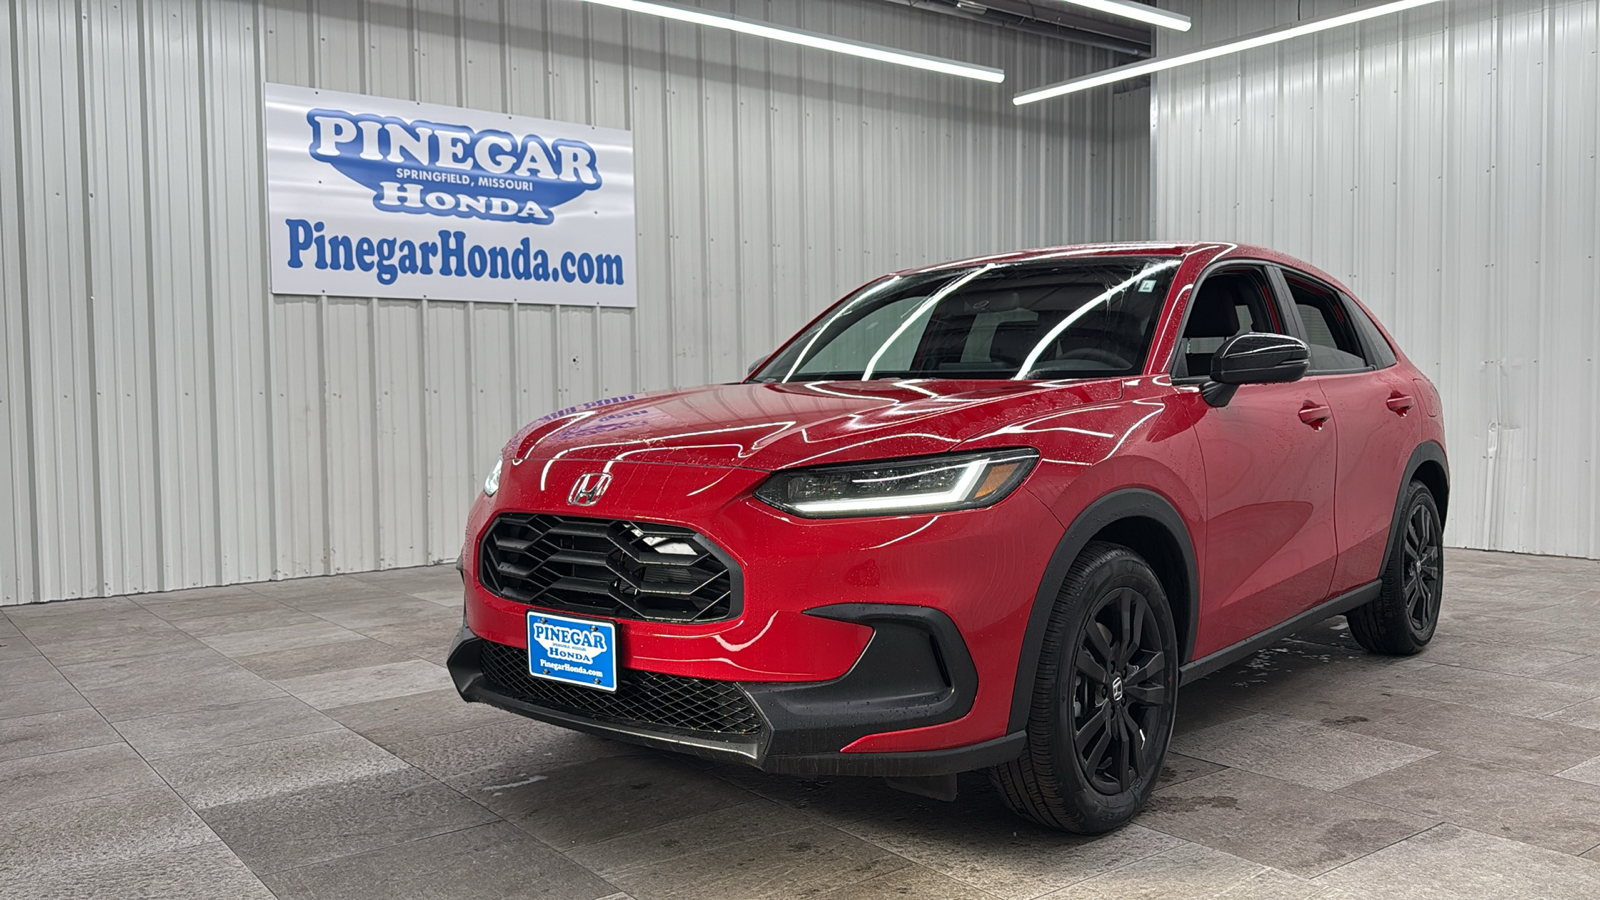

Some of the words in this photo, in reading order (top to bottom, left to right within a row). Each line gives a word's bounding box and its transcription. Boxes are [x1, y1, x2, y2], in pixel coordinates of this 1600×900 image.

[314, 116, 597, 184] PINEGAR
[396, 168, 475, 187] SPRINGFIELD,
[478, 176, 533, 192] MISSOURI
[380, 182, 548, 219] HONDA
[285, 219, 624, 285] PinegarHonda.com
[536, 625, 604, 649] PINEGAR
[549, 647, 591, 662] HONDA
[540, 659, 603, 677] PinegarHonda.com
